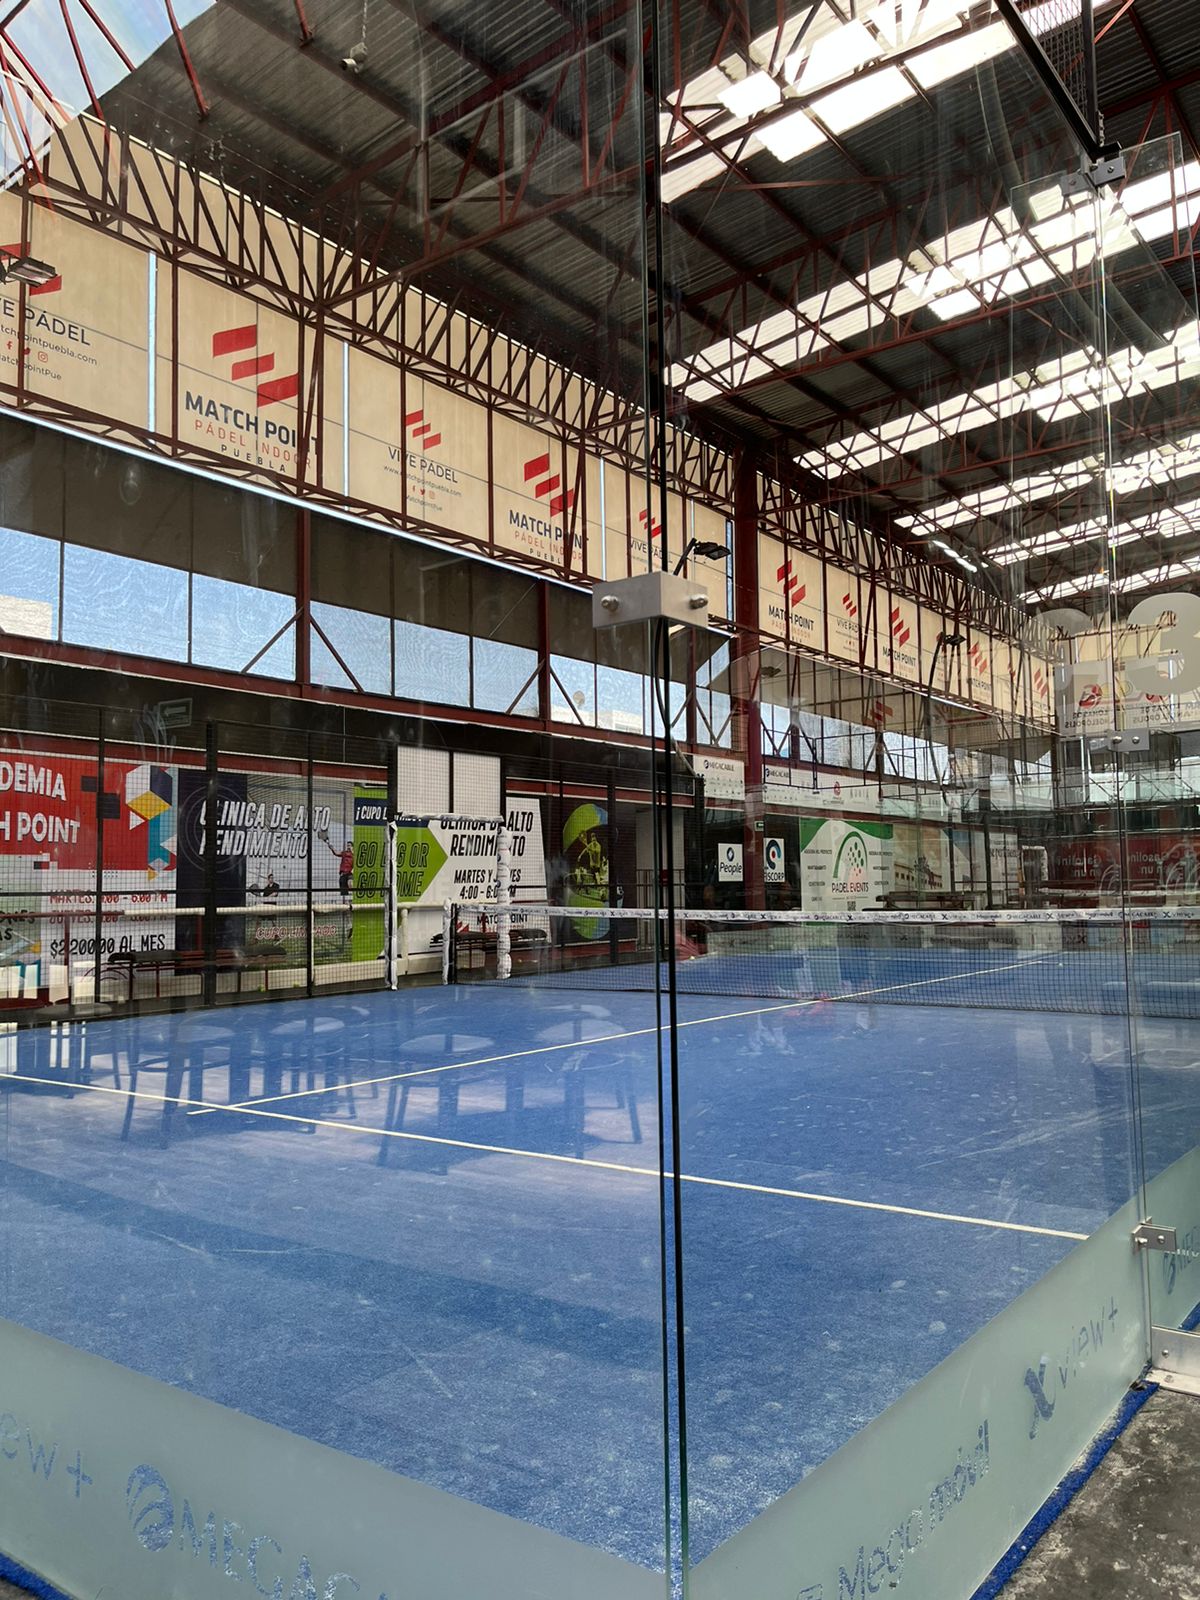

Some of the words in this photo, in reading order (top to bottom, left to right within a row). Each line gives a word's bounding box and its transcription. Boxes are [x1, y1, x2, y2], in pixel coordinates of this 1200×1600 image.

[25, 307, 91, 346] PÁDEL
[1, 324, 98, 365] tchointpuebla.com
[185, 390, 258, 435] MATCH
[195, 419, 246, 447] PÁDEL
[221, 444, 286, 473] PUEBLA
[388, 446, 416, 468] VIE
[509, 509, 552, 538] MATCH
[530, 548, 561, 564] PUEBL
[768, 604, 794, 624] MATH
[794, 613, 814, 631] POINT
[17, 811, 80, 843] POINT
[270, 804, 292, 829] DE
[507, 811, 534, 832] ALTO
[356, 841, 378, 868] GO
[409, 842, 430, 868] OR
[450, 834, 526, 857] RENDIMITO
[454, 869, 486, 884] MARTES
[488, 869, 494, 883] Y
[720, 861, 743, 876] People
[356, 871, 378, 898] GO
[460, 885, 479, 900] 4:00
[486, 885, 498, 900] 6:0
[832, 882, 849, 893] PADEL
[850, 881, 869, 893] EVENTS
[119, 935, 136, 954] AL
[141, 933, 166, 952] MES
[180, 1498, 389, 1600] MEGA
